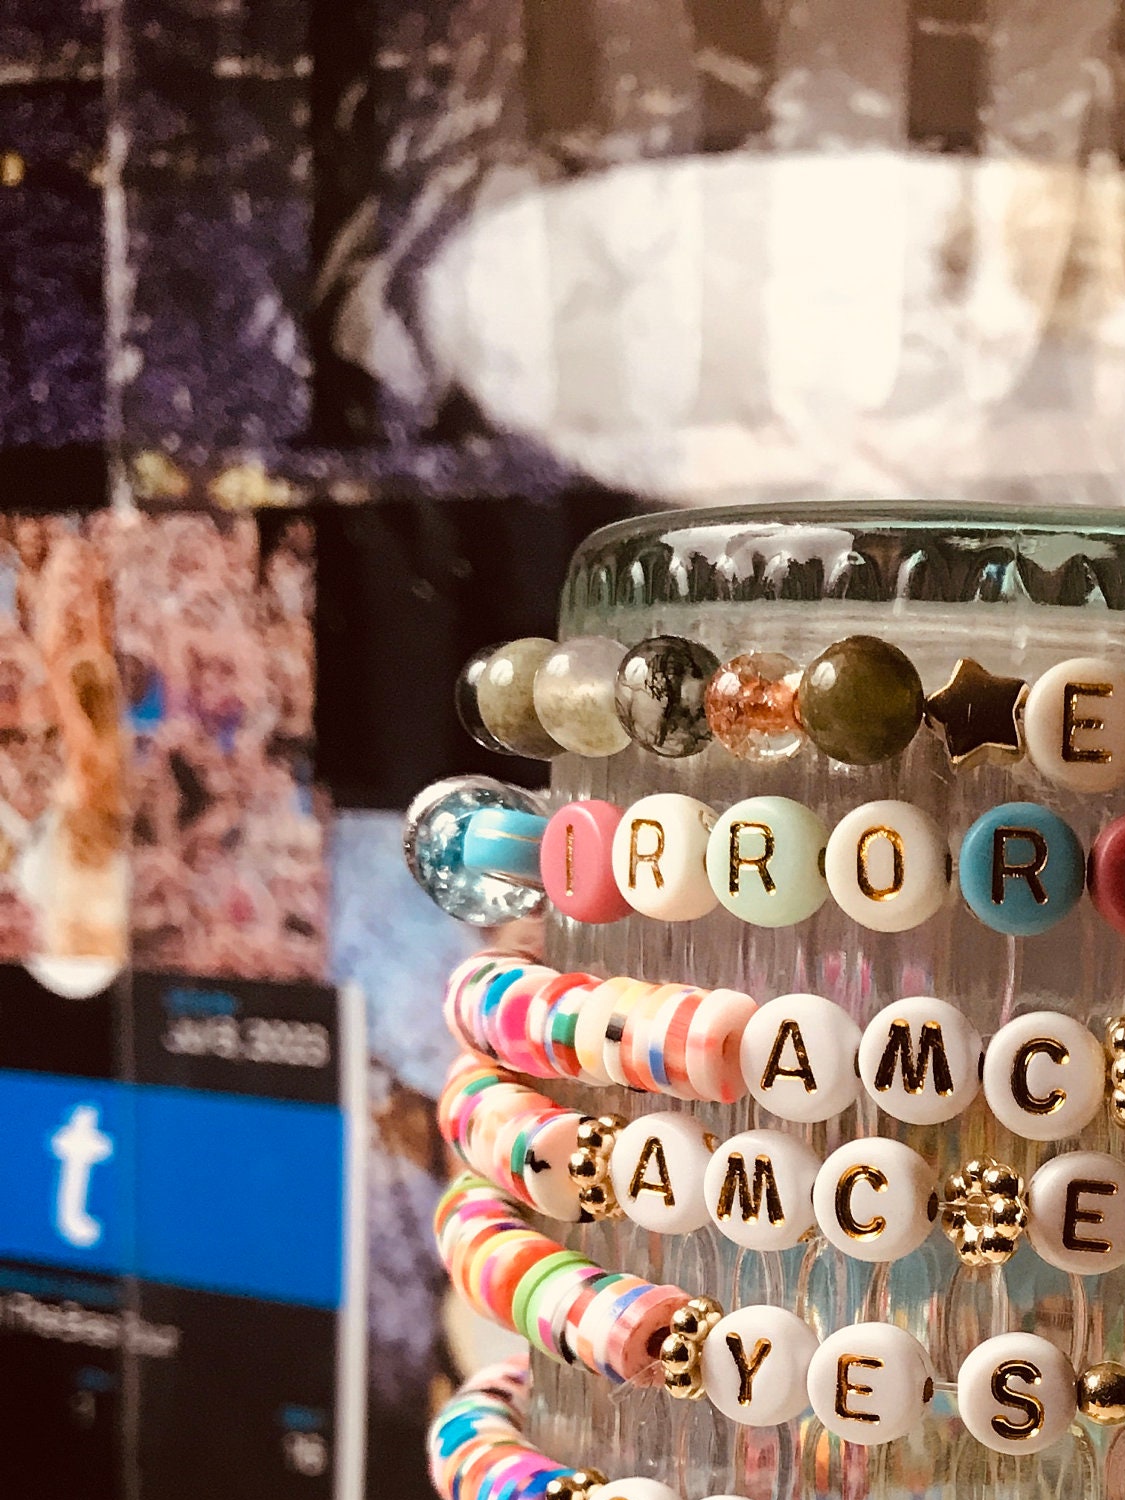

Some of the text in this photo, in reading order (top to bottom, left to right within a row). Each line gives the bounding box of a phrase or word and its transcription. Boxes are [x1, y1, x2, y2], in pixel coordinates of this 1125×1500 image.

[760, 1018, 1072, 1115] AMC
[628, 1137, 889, 1243] AMC
[725, 1332, 1046, 1441] YES
